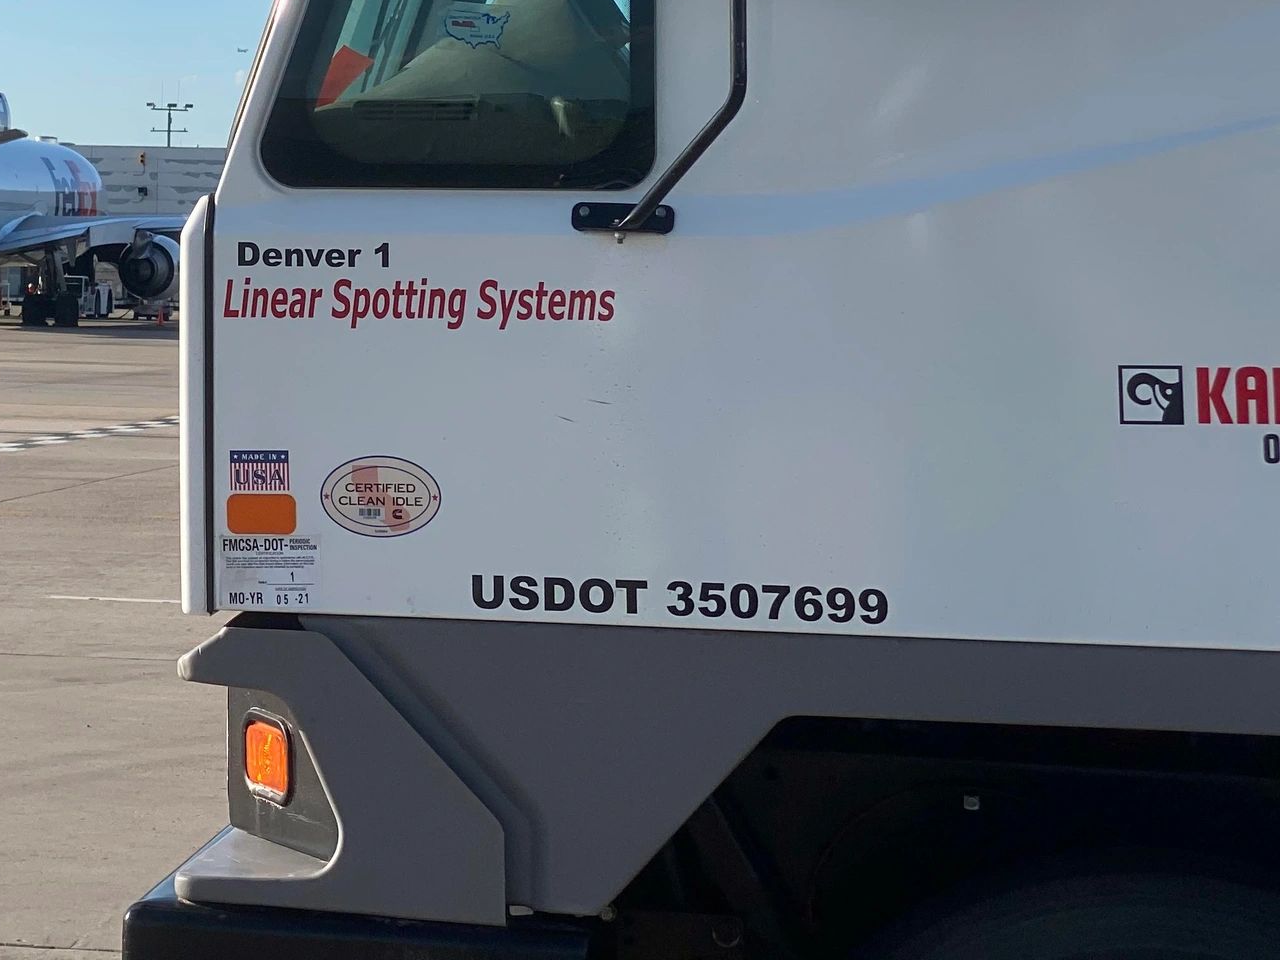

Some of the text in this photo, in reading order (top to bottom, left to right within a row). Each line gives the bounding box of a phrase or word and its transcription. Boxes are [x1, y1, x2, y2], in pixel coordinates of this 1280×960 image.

[237, 242, 390, 268] Denver 1
[223, 277, 616, 330] Linear Spotting Systems
[1196, 367, 1280, 425] KA
[241, 453, 277, 461] MADE IN
[235, 468, 285, 486] USA
[345, 482, 416, 493] CERTIFIED
[338, 495, 423, 507] CLEAN IDLE
[290, 571, 295, 582] 1
[229, 592, 264, 605] MO-YR
[471, 574, 889, 624] USDOT 3507699
